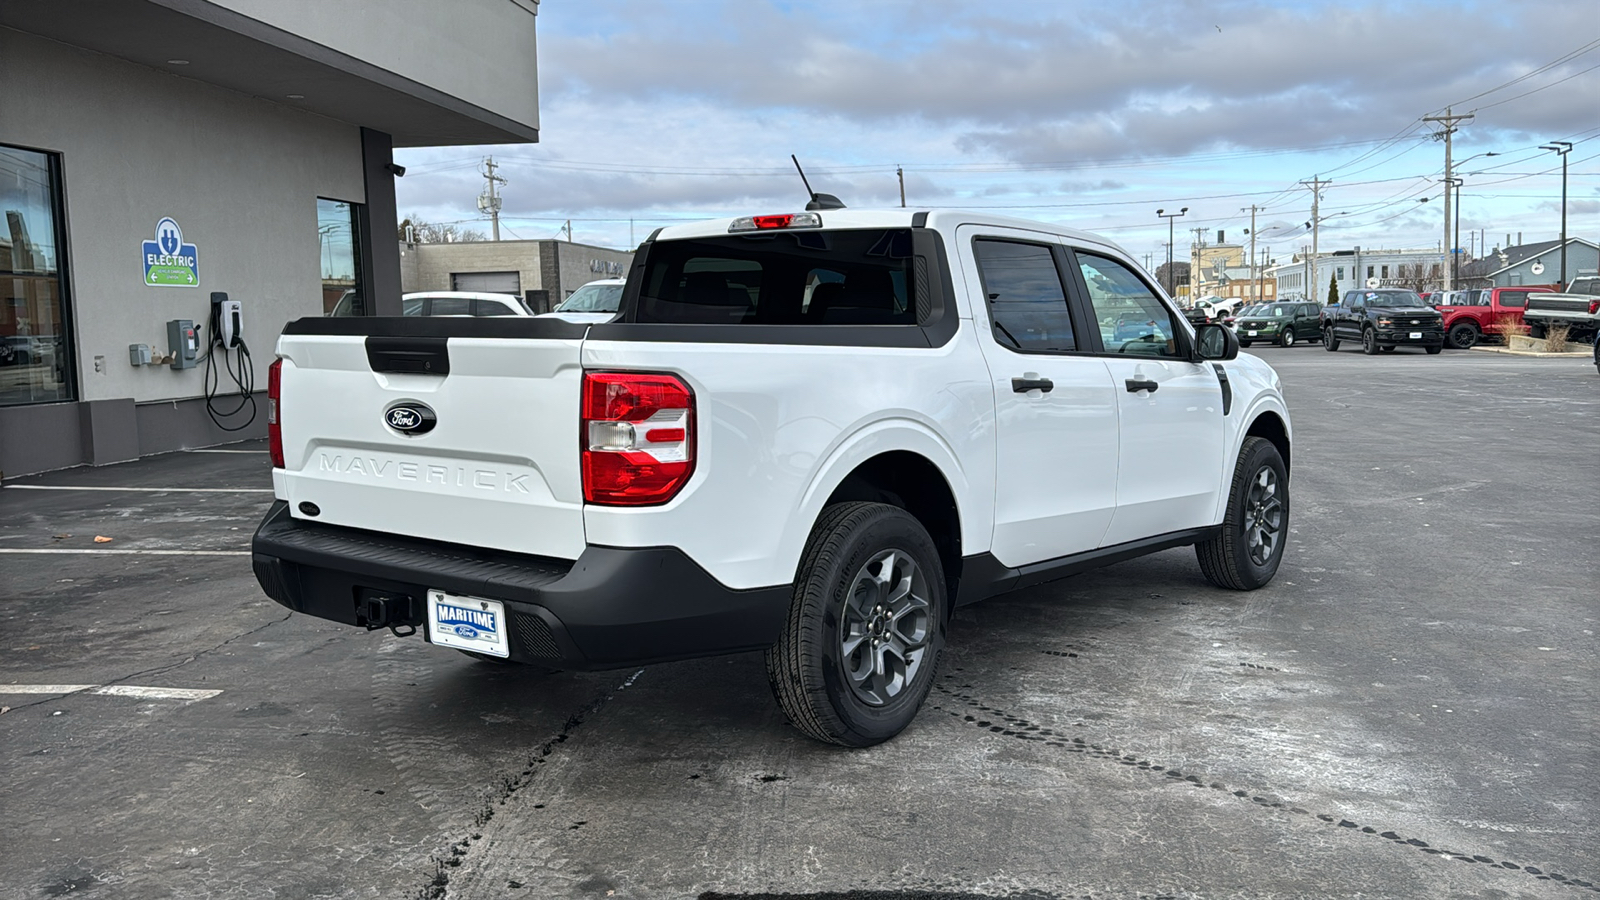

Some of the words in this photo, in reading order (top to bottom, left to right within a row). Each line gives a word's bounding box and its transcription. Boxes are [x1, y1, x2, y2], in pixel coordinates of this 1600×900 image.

[147, 254, 194, 267] ELECTRIC
[392, 410, 415, 426] Ford
[319, 453, 530, 494] MAVERICK
[438, 604, 495, 631] MARITIME
[458, 627, 475, 638] Ford
